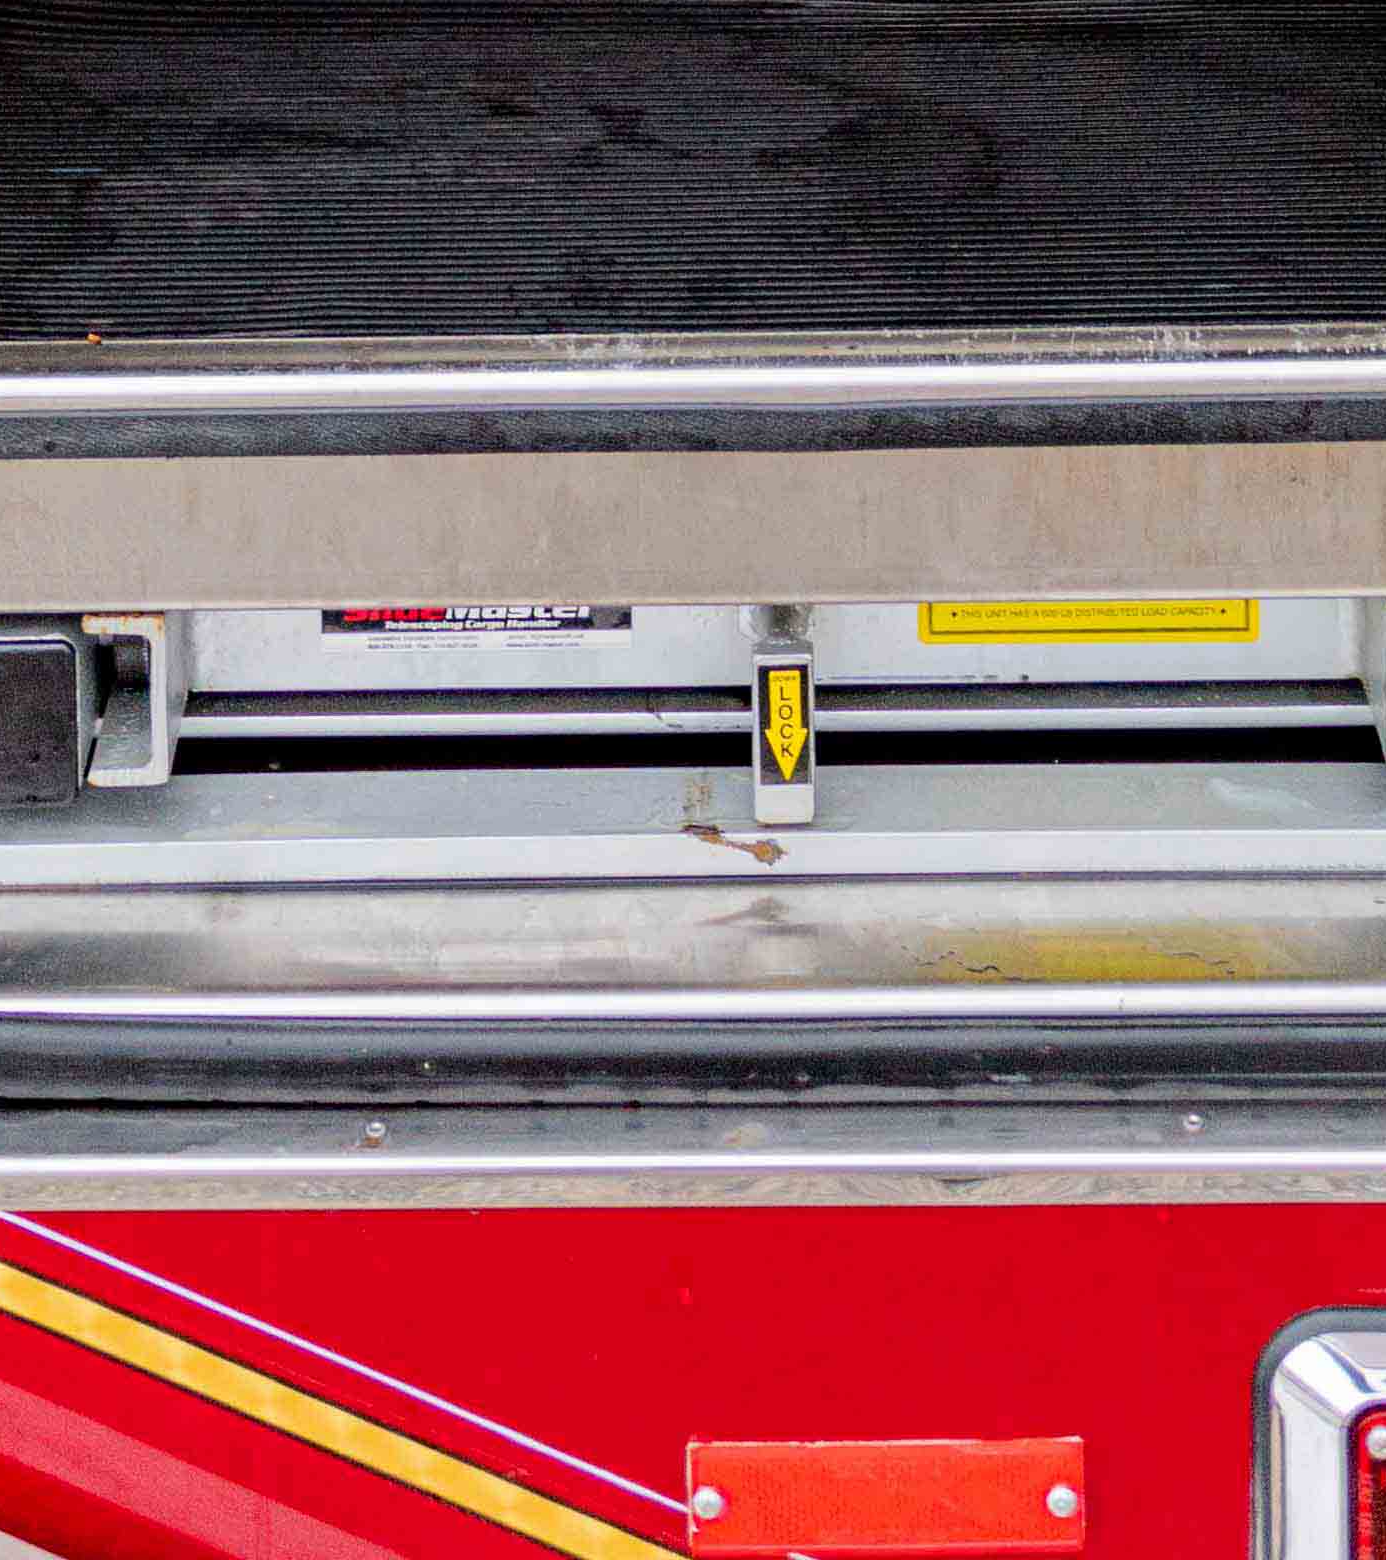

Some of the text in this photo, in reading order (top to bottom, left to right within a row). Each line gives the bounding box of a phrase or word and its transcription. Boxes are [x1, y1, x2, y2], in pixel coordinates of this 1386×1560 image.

[984, 608, 1007, 619] UNIT
[1074, 607, 1139, 618] DISTRIBUTED
[1140, 606, 1168, 617] LOAD
[1170, 606, 1217, 617] CAPACITY
[385, 618, 562, 632] Telescoping Cargo Handler
[778, 686, 794, 757] LOCK
